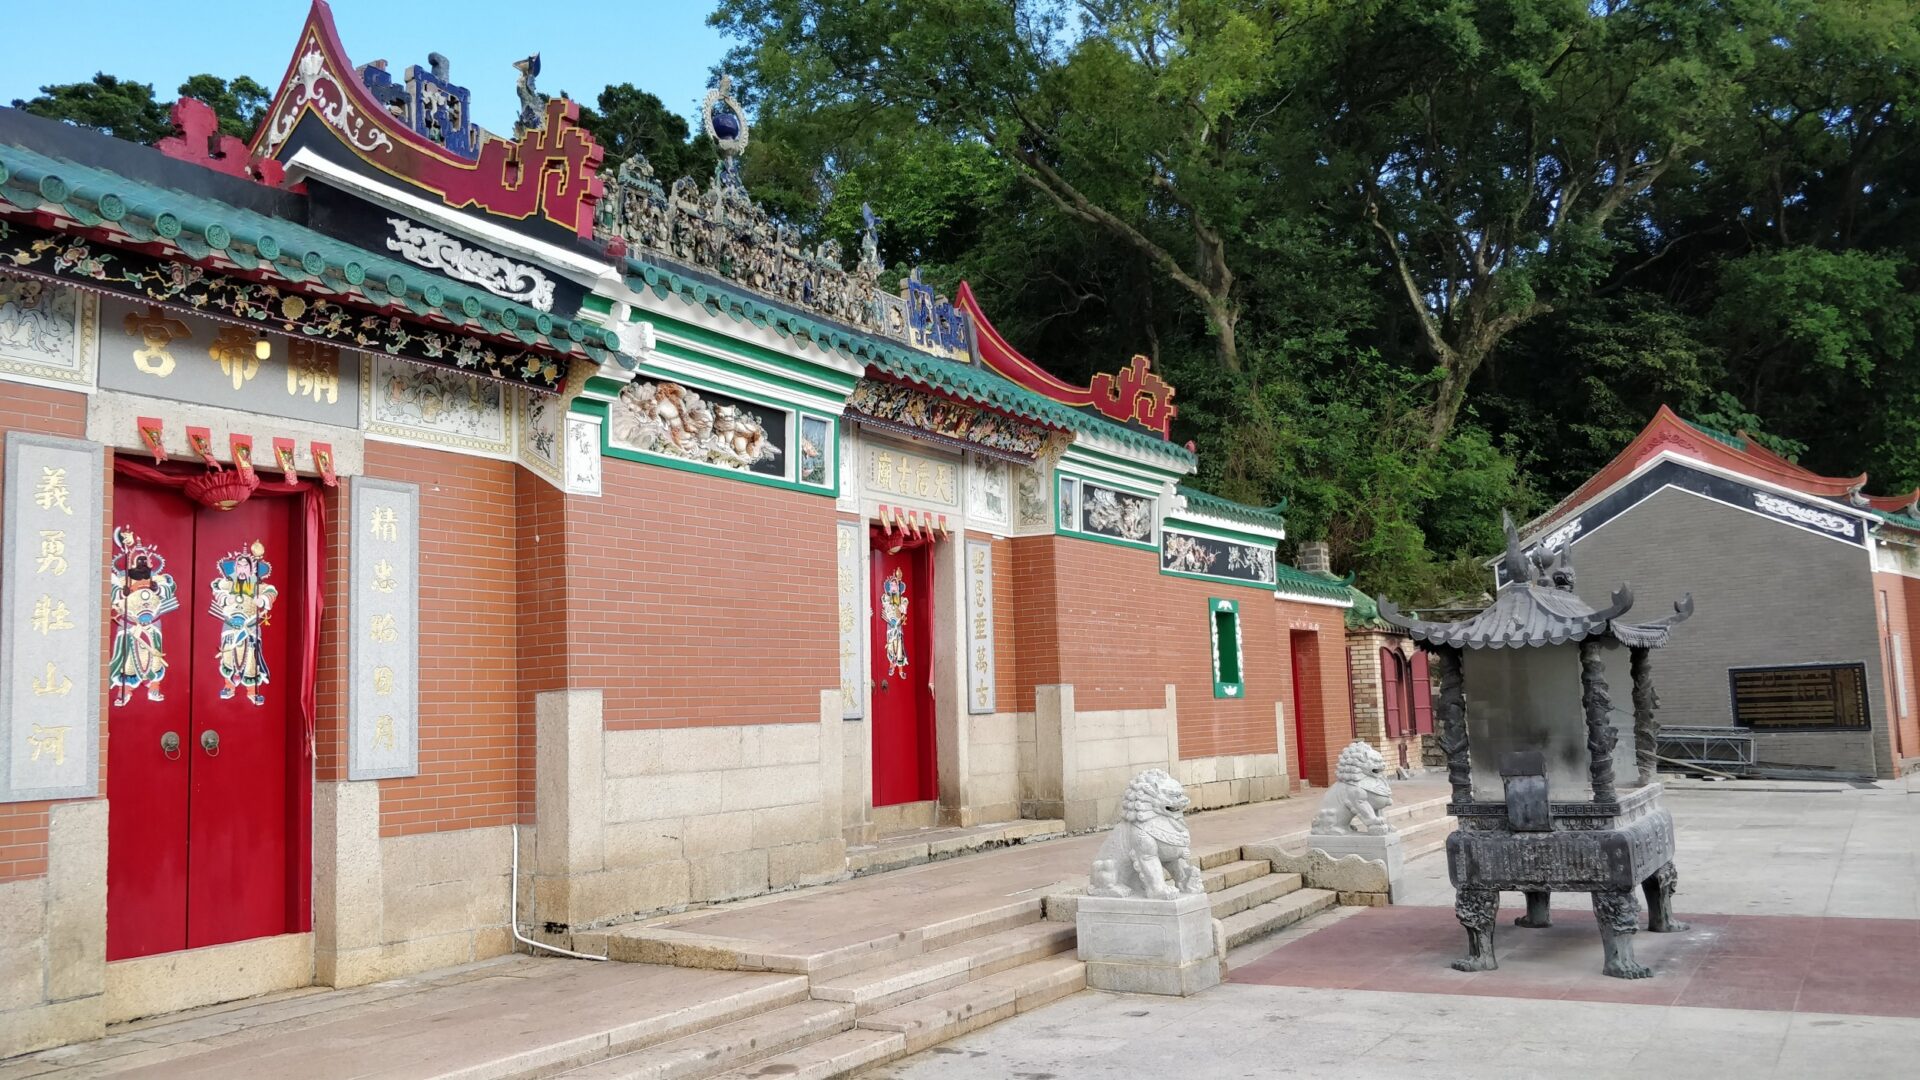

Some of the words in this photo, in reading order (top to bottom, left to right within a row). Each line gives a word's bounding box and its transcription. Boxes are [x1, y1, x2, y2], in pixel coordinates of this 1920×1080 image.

[124, 305, 341, 404] 關帝宮
[878, 452, 951, 502] 天后古廟
[27, 466, 75, 766] 義勇壯山河
